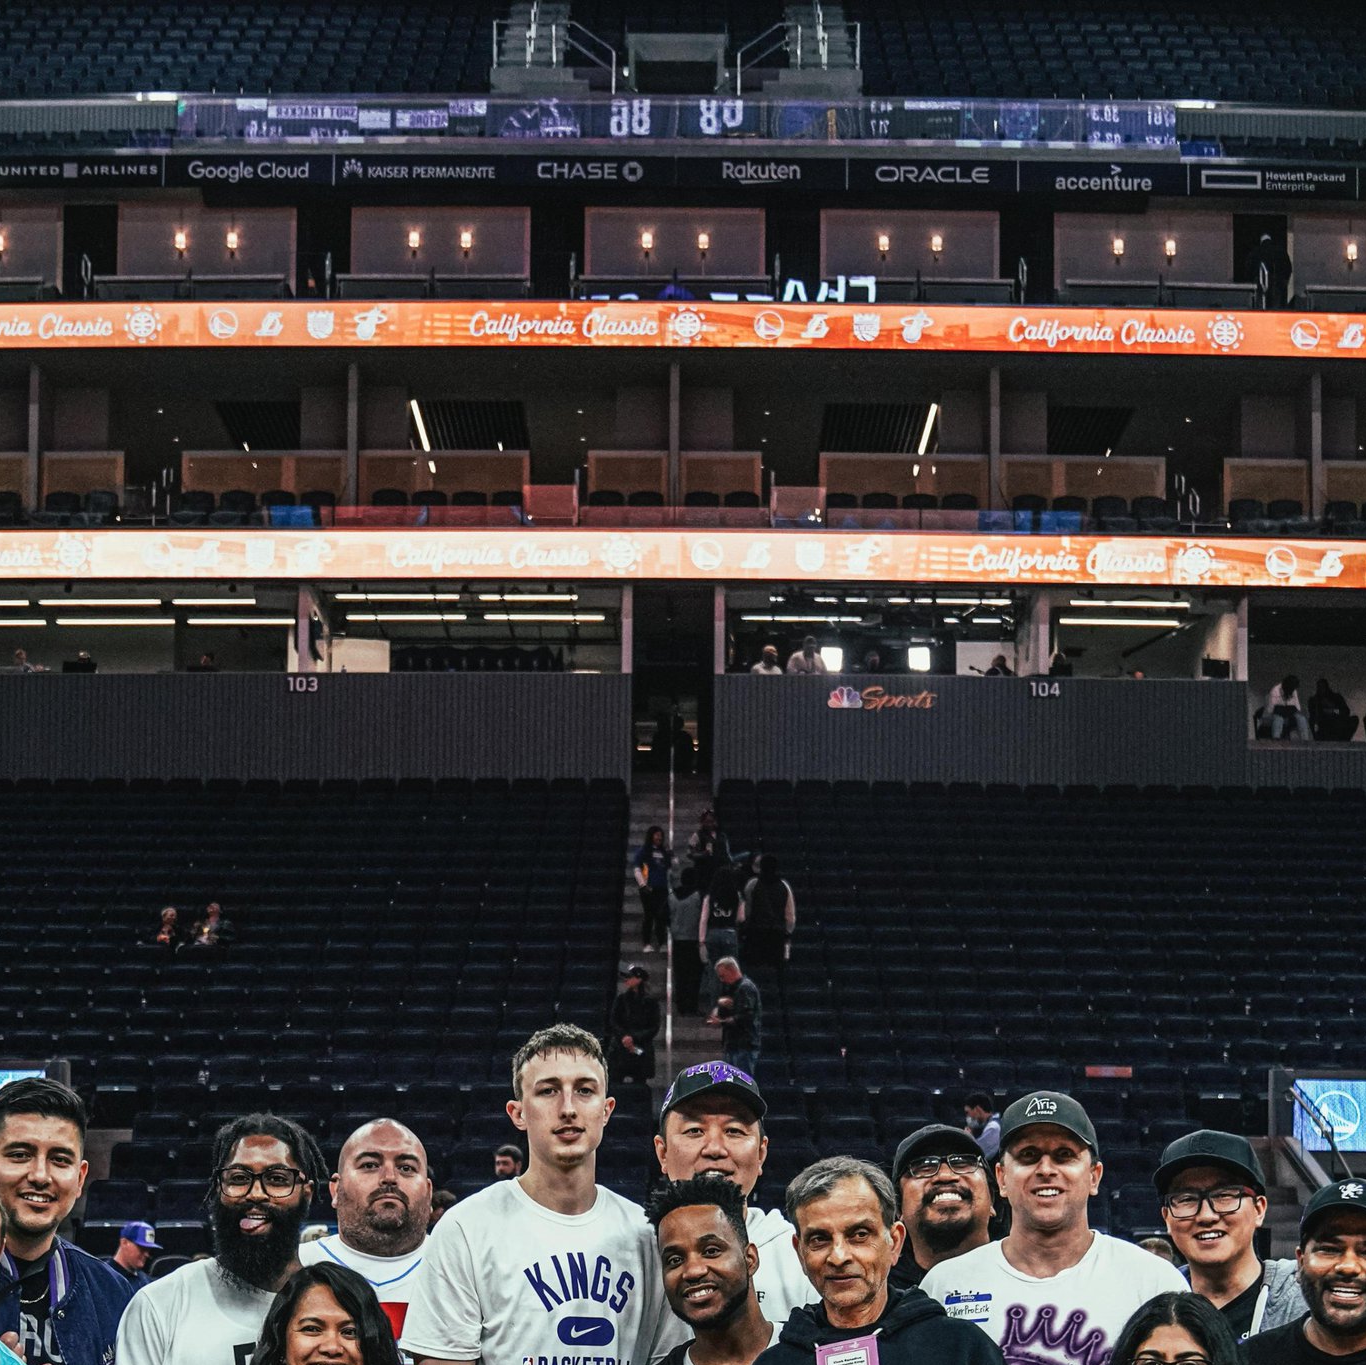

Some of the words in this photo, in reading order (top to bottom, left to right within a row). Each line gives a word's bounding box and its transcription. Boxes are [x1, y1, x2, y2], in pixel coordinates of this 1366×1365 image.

[0, 165, 60, 176] UNITED
[81, 164, 159, 176] AIRLINES
[188, 160, 255, 182] Google
[257, 160, 310, 178] Cloud
[367, 166, 409, 179] KAISER
[412, 166, 497, 179] PERMANENTE
[537, 162, 618, 180] CHASE
[722, 161, 802, 181] Rakuten
[875, 166, 991, 183] ORACLE
[1266, 171, 1306, 182] Hewlett
[1307, 172, 1346, 182] Packard
[1055, 173, 1153, 191] accenture
[1266, 181, 1316, 193] Enterprise
[37, 313, 113, 338] Classic
[469, 310, 575, 341] California
[581, 311, 659, 338] Classic
[1008, 316, 1115, 348] California
[1120, 318, 1196, 345] Classic
[390, 541, 501, 574] California
[508, 541, 590, 569] Classic
[968, 545, 1080, 579] California
[1086, 546, 1166, 575] Classic
[287, 676, 319, 691] 103
[1029, 682, 1061, 697] 104
[862, 685, 938, 711] Sports
[523, 1252, 636, 1314] KINGS
